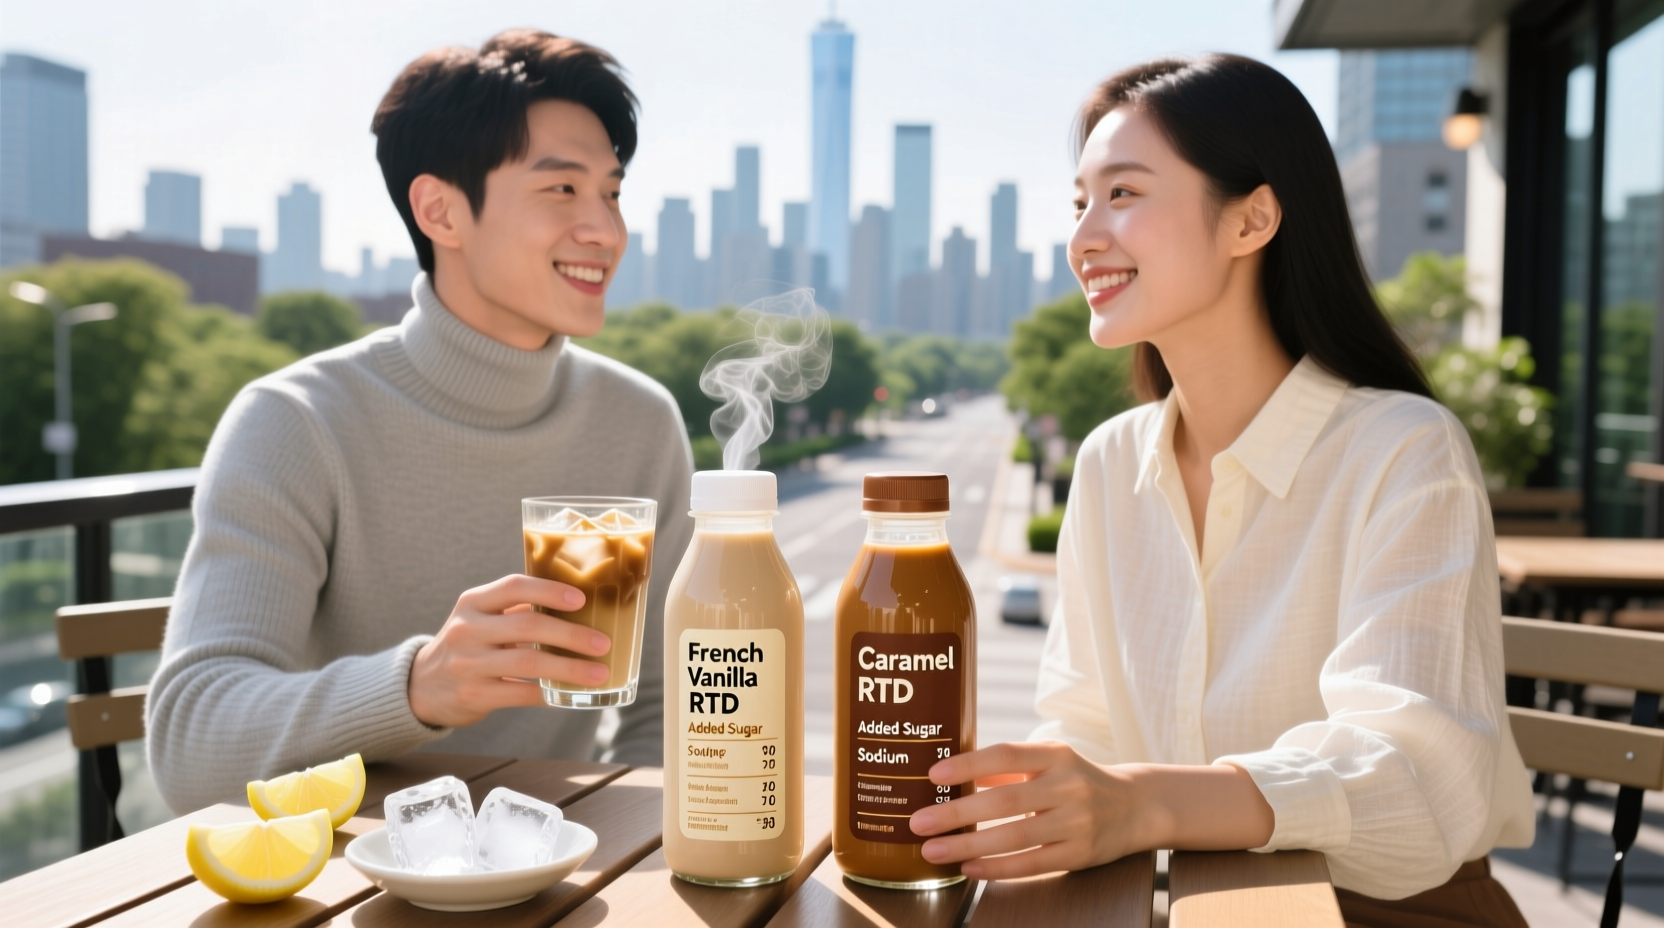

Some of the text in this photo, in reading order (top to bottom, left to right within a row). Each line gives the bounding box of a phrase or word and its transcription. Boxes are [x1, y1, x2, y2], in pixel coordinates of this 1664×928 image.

[688, 641, 764, 663] French
[858, 645, 955, 671] Caramel
[687, 666, 758, 688] Vanilla
[858, 676, 914, 704] RTD
[689, 691, 740, 715] RTD
[688, 721, 763, 738] Added Sugar
[857, 720, 943, 739] Added Sugar
[857, 747, 909, 764] Sodium
